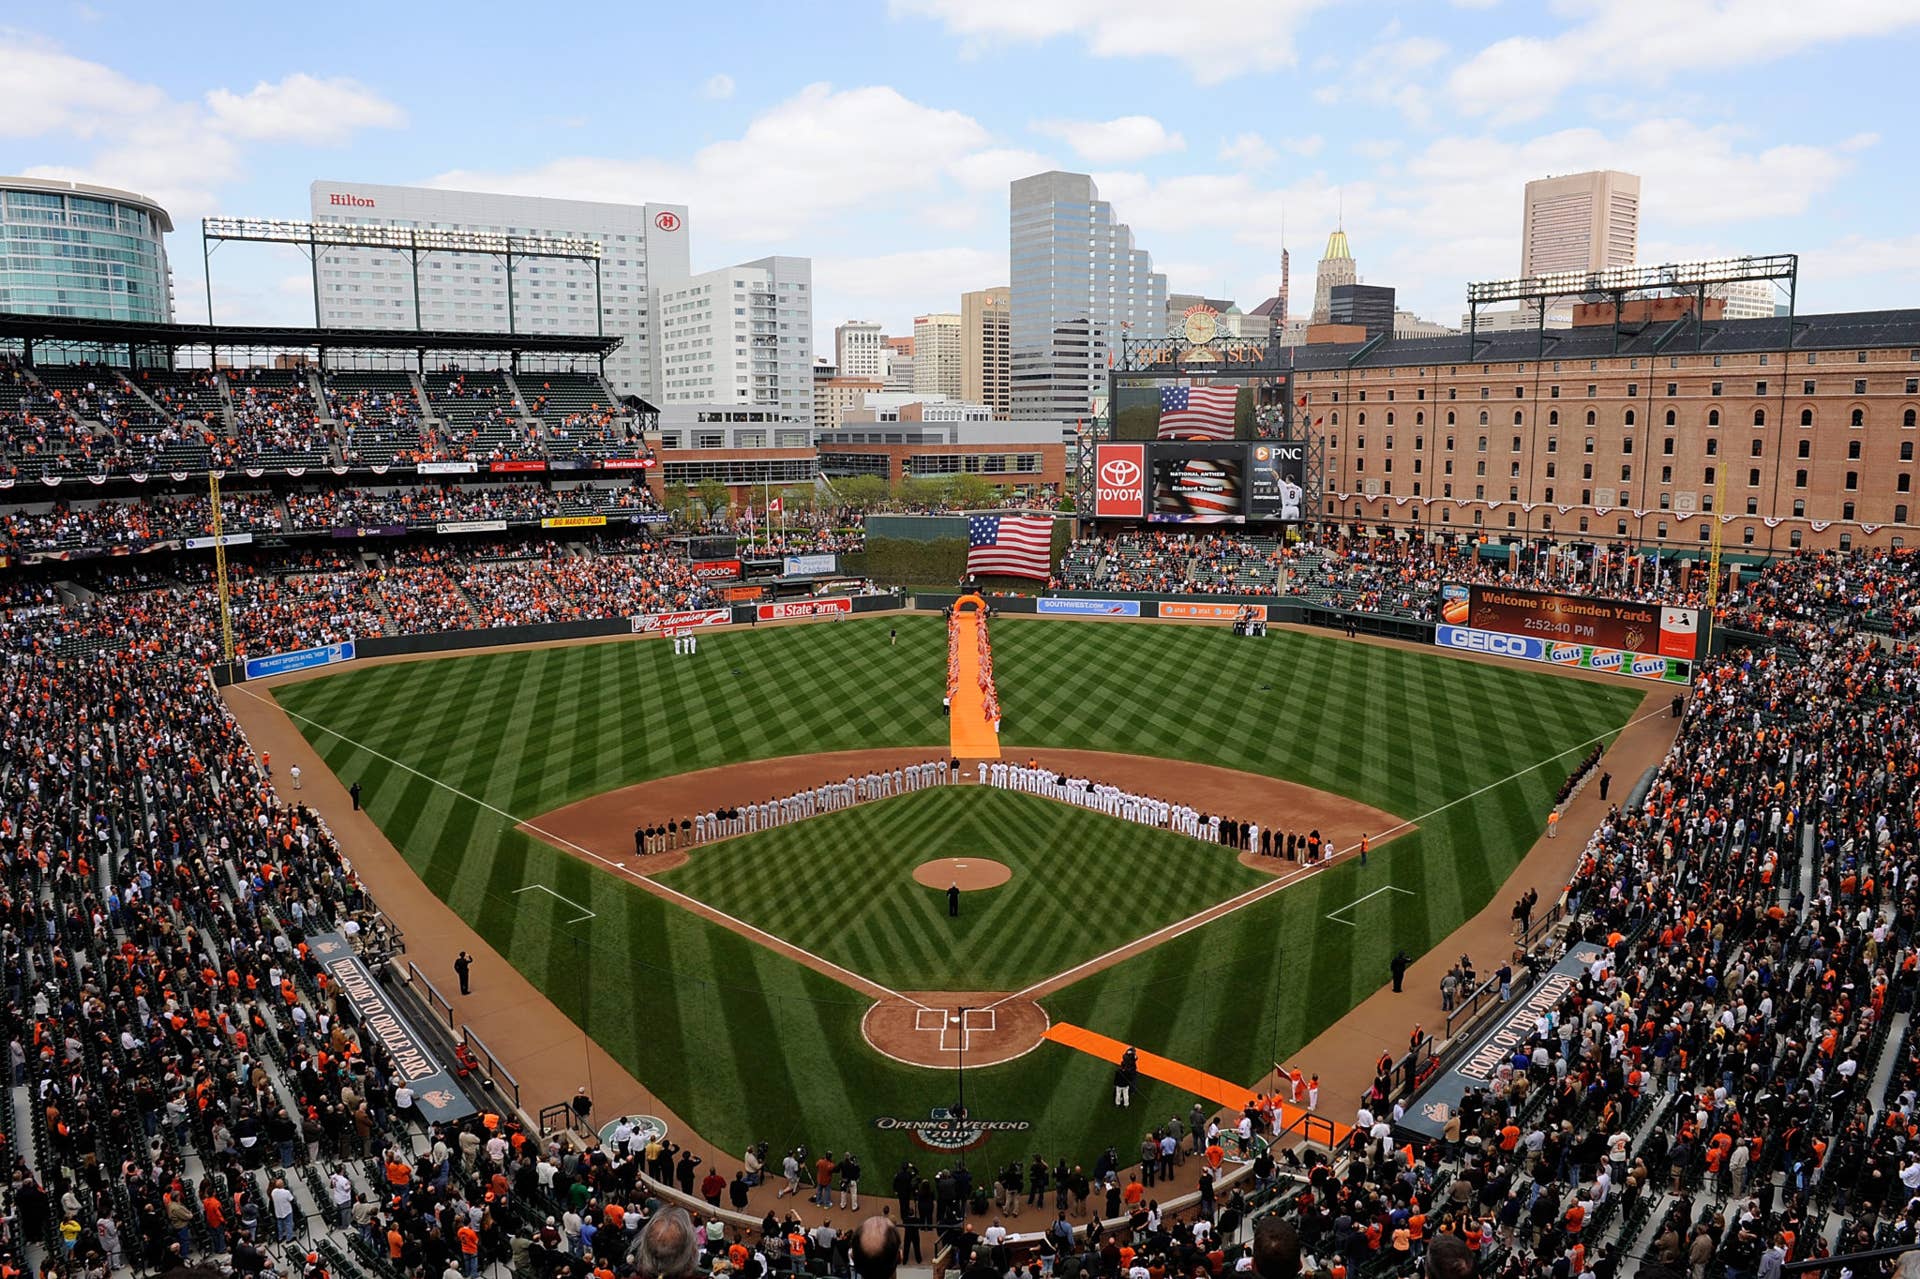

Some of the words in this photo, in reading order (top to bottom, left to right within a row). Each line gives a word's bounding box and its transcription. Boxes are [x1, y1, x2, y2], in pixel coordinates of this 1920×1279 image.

[330, 193, 375, 208] Hilton
[1136, 347, 1173, 363] THE
[1228, 345, 1265, 362] SUN
[1272, 448, 1302, 460] PNC
[1097, 489, 1143, 501] TOYOTA
[1289, 490, 1296, 499] 8
[587, 517, 602, 525] PIZZA
[786, 604, 812, 616] State
[813, 602, 838, 615] arm
[1482, 591, 1537, 610] Welcome
[1540, 599, 1557, 612] To
[1559, 601, 1611, 619] Camden
[1615, 608, 1652, 623] Yards
[1524, 618, 1570, 634] 2:52:40
[1574, 625, 1595, 638] PM
[1451, 628, 1526, 656] GEICO
[1552, 648, 1581, 663] Gulf
[1591, 654, 1622, 668] Gulf
[1632, 660, 1664, 675] Gulf
[332, 958, 375, 1001] WELCOME
[1528, 975, 1575, 1012] ORIOLES
[360, 998, 385, 1015] TO
[1506, 1008, 1540, 1032] THE
[369, 1013, 412, 1050] ORIOLE
[1494, 1030, 1521, 1048] OF
[394, 1046, 433, 1080] PARK
[1461, 1042, 1508, 1078] HOME
[876, 1117, 949, 1130] OPENING
[956, 1120, 1030, 1130] WEEKEND
[931, 1130, 968, 1138] 2010
